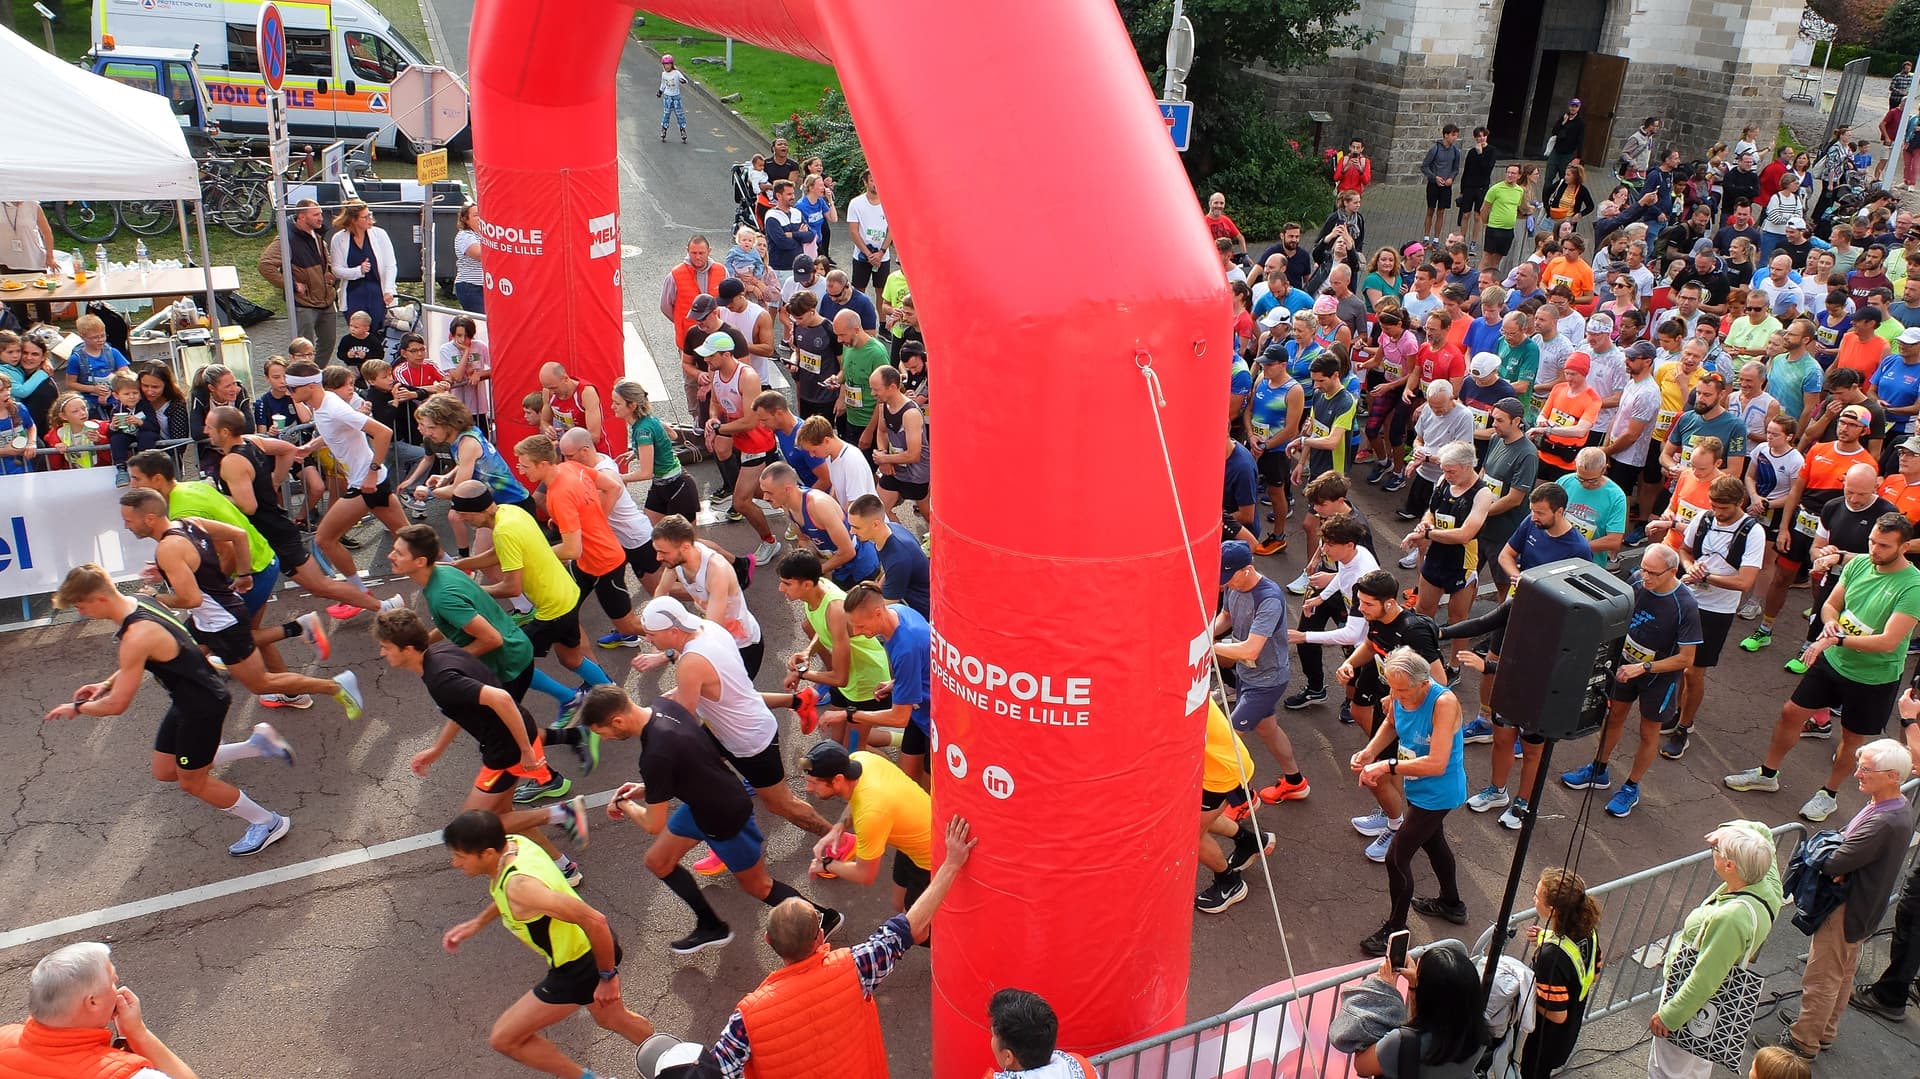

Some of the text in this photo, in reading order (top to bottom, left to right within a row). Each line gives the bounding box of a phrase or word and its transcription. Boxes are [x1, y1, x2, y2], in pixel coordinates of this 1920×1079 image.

[422, 155, 445, 169] CONTOUR
[500, 243, 512, 253] DE
[514, 245, 543, 256] LILLE
[1314, 426, 1324, 438] 25
[1625, 643, 1646, 661] 277
[994, 700, 1022, 720] DE
[1028, 706, 1090, 726] LILLE
